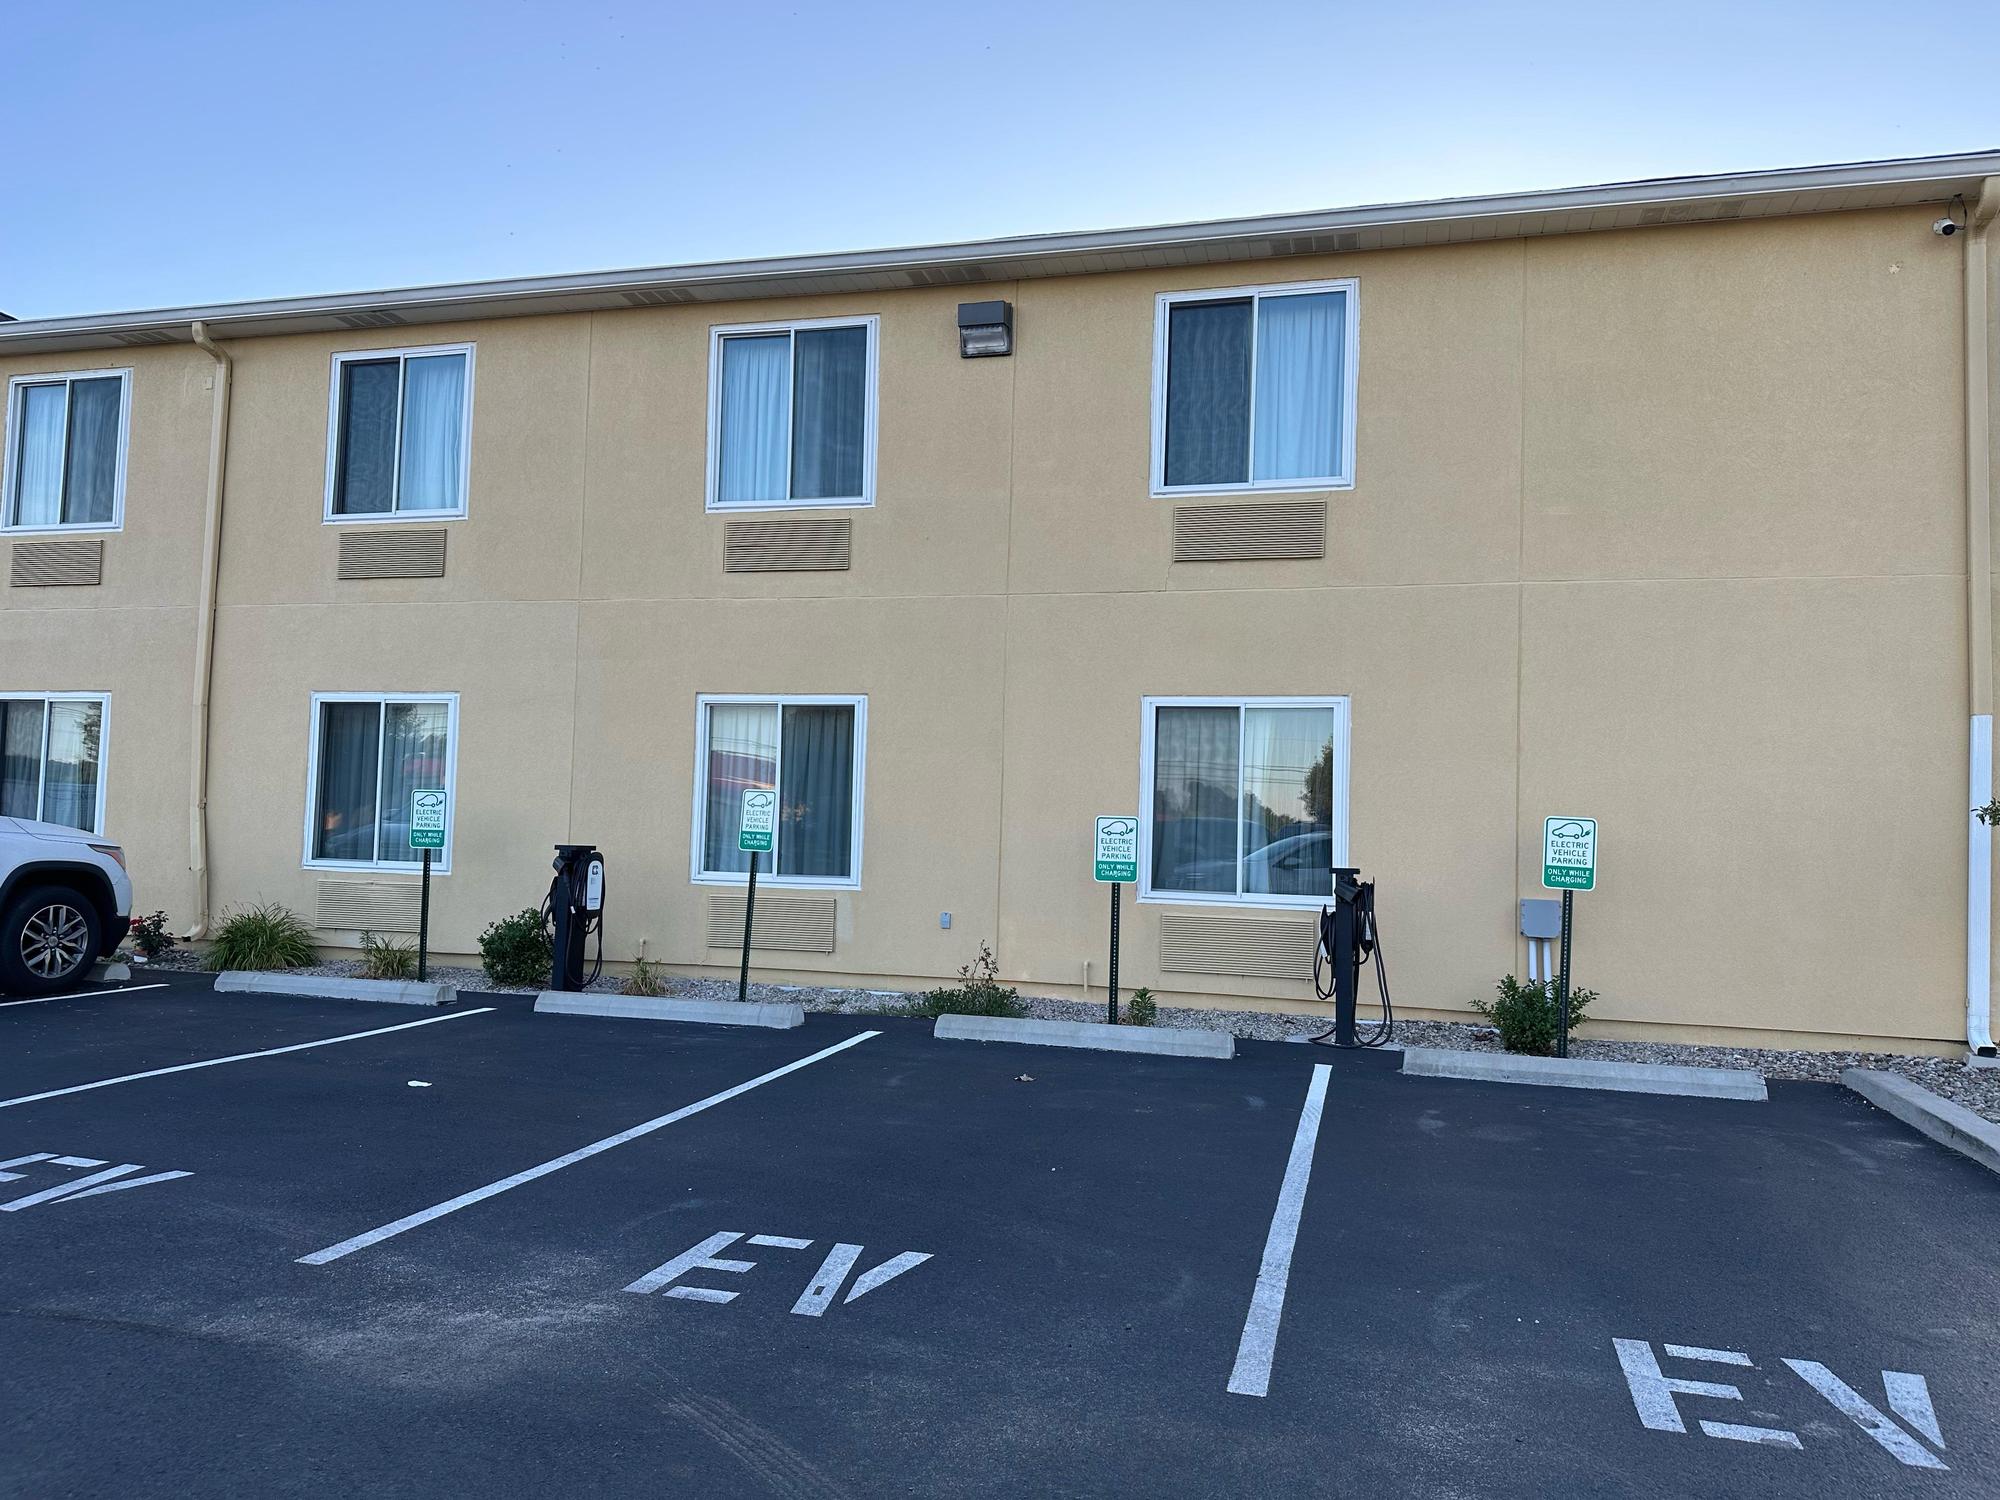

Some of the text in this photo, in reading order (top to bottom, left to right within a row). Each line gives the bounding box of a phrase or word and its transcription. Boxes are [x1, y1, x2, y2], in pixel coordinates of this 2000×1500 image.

[1551, 840, 1589, 850] ELECTRIC
[1553, 849, 1587, 857] VEHICLE
[1552, 857, 1588, 866] PARKING
[1551, 876, 1587, 884] CHARGING
[621, 1231, 935, 1317] EV
[1612, 1338, 1951, 1470] EV
